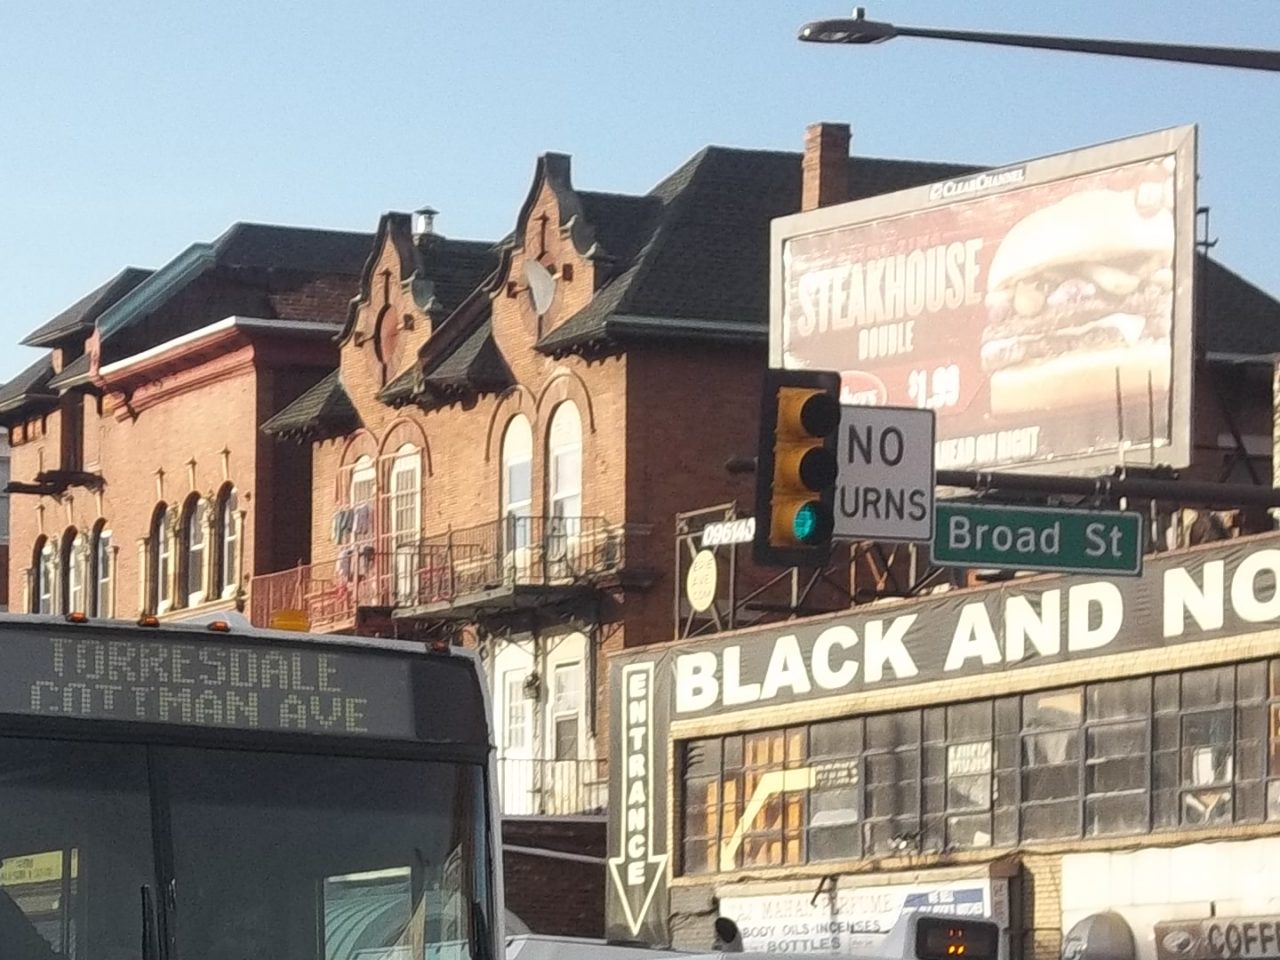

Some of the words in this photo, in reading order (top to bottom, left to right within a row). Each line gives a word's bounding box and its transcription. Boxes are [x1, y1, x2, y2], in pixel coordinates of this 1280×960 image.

[796, 238, 983, 337] STEAKHOUSE
[858, 320, 916, 361] DOUBLE
[848, 424, 904, 467] NO
[837, 486, 928, 521] URNS
[948, 514, 1060, 556] Broad
[1085, 520, 1123, 557] St
[49, 636, 343, 693] TORRESDALE
[675, 612, 919, 713] BLACK
[942, 580, 1124, 671] AND
[30, 679, 259, 728] COTTMAN
[279, 692, 369, 733] AVE
[627, 672, 648, 886] ENTRANCE
[742, 925, 777, 939] BODY
[766, 935, 842, 953] BOTTLES
